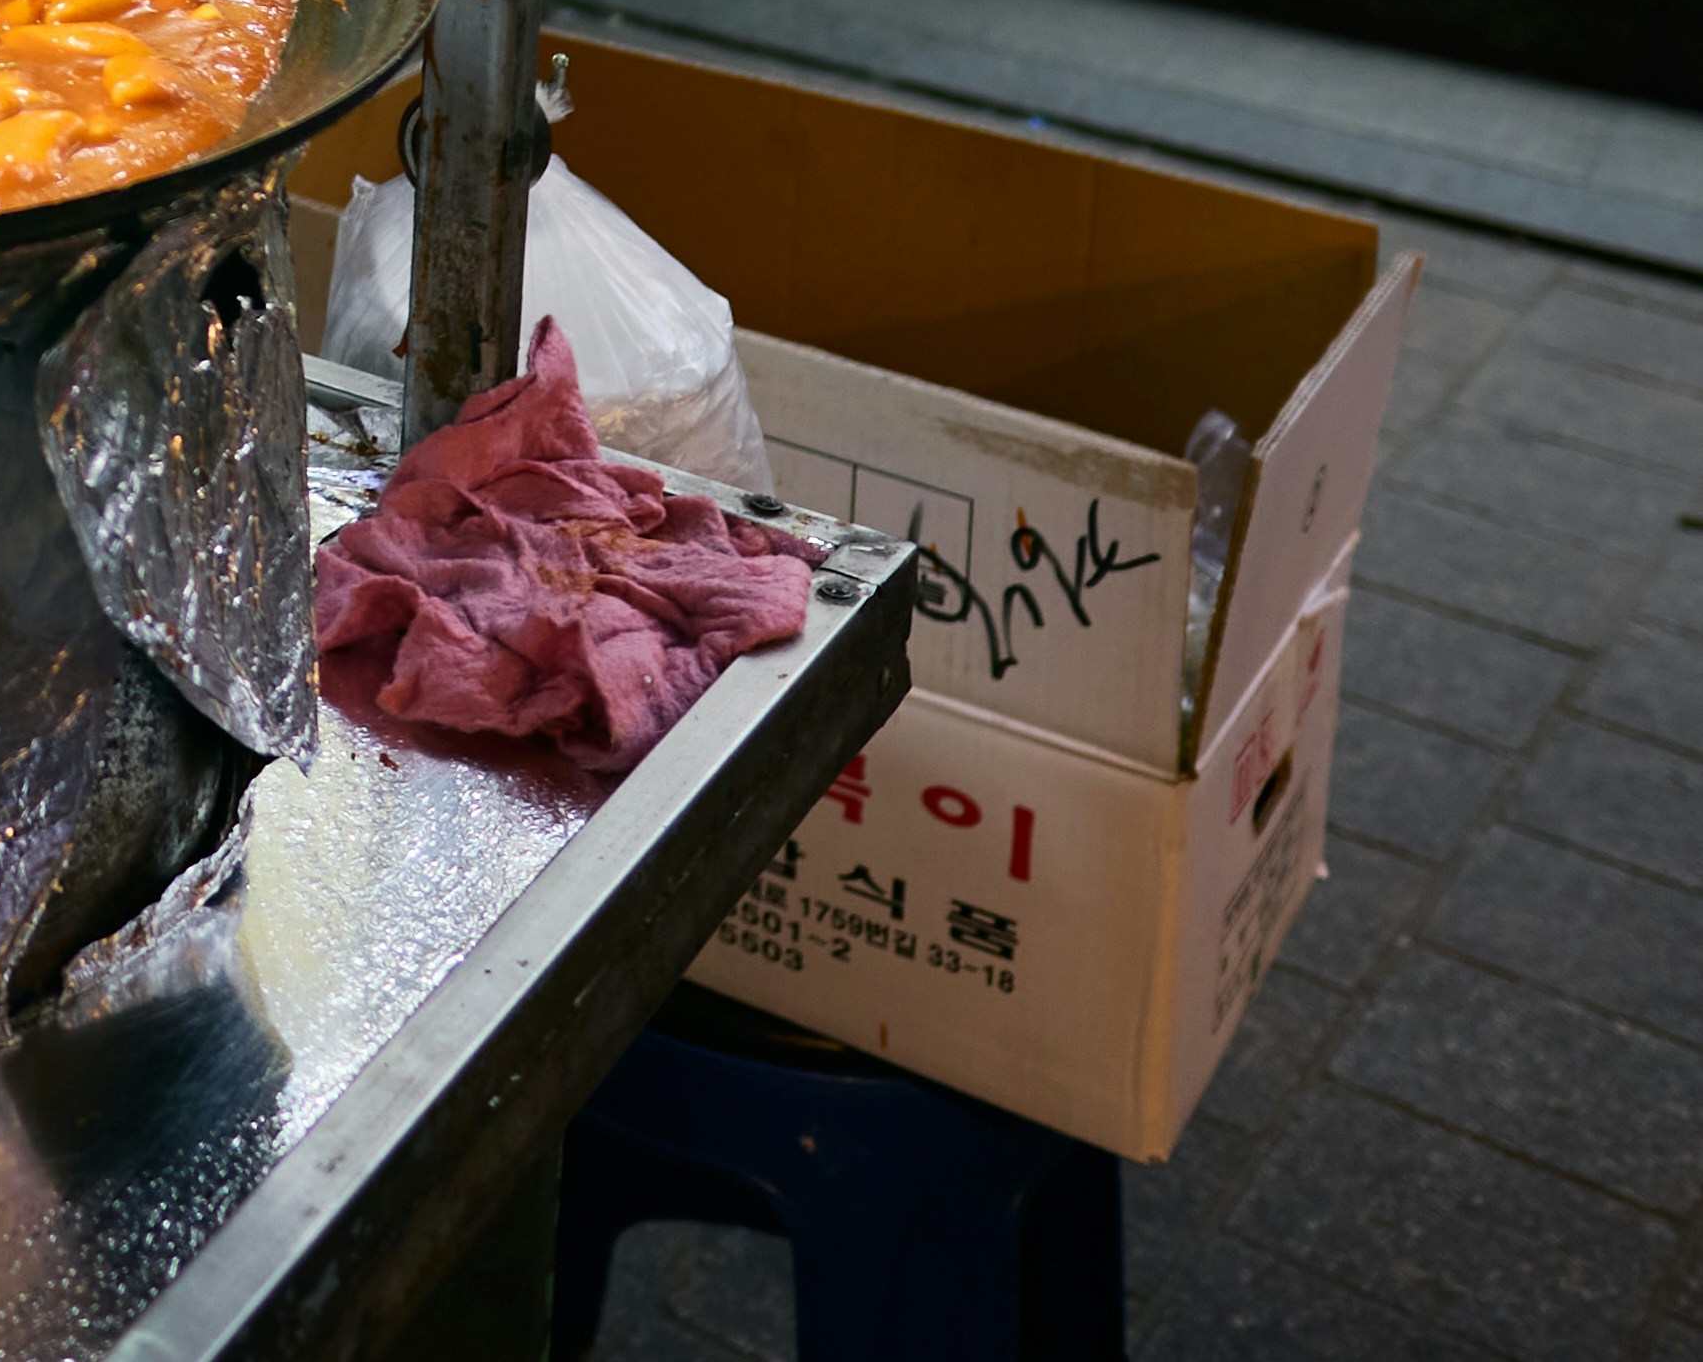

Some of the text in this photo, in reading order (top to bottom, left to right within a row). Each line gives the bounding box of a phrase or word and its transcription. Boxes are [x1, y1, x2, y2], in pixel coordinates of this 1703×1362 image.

[729, 900, 852, 963] 501~2
[799, 896, 917, 960] 1759번길
[927, 943, 1015, 994] 33-18
